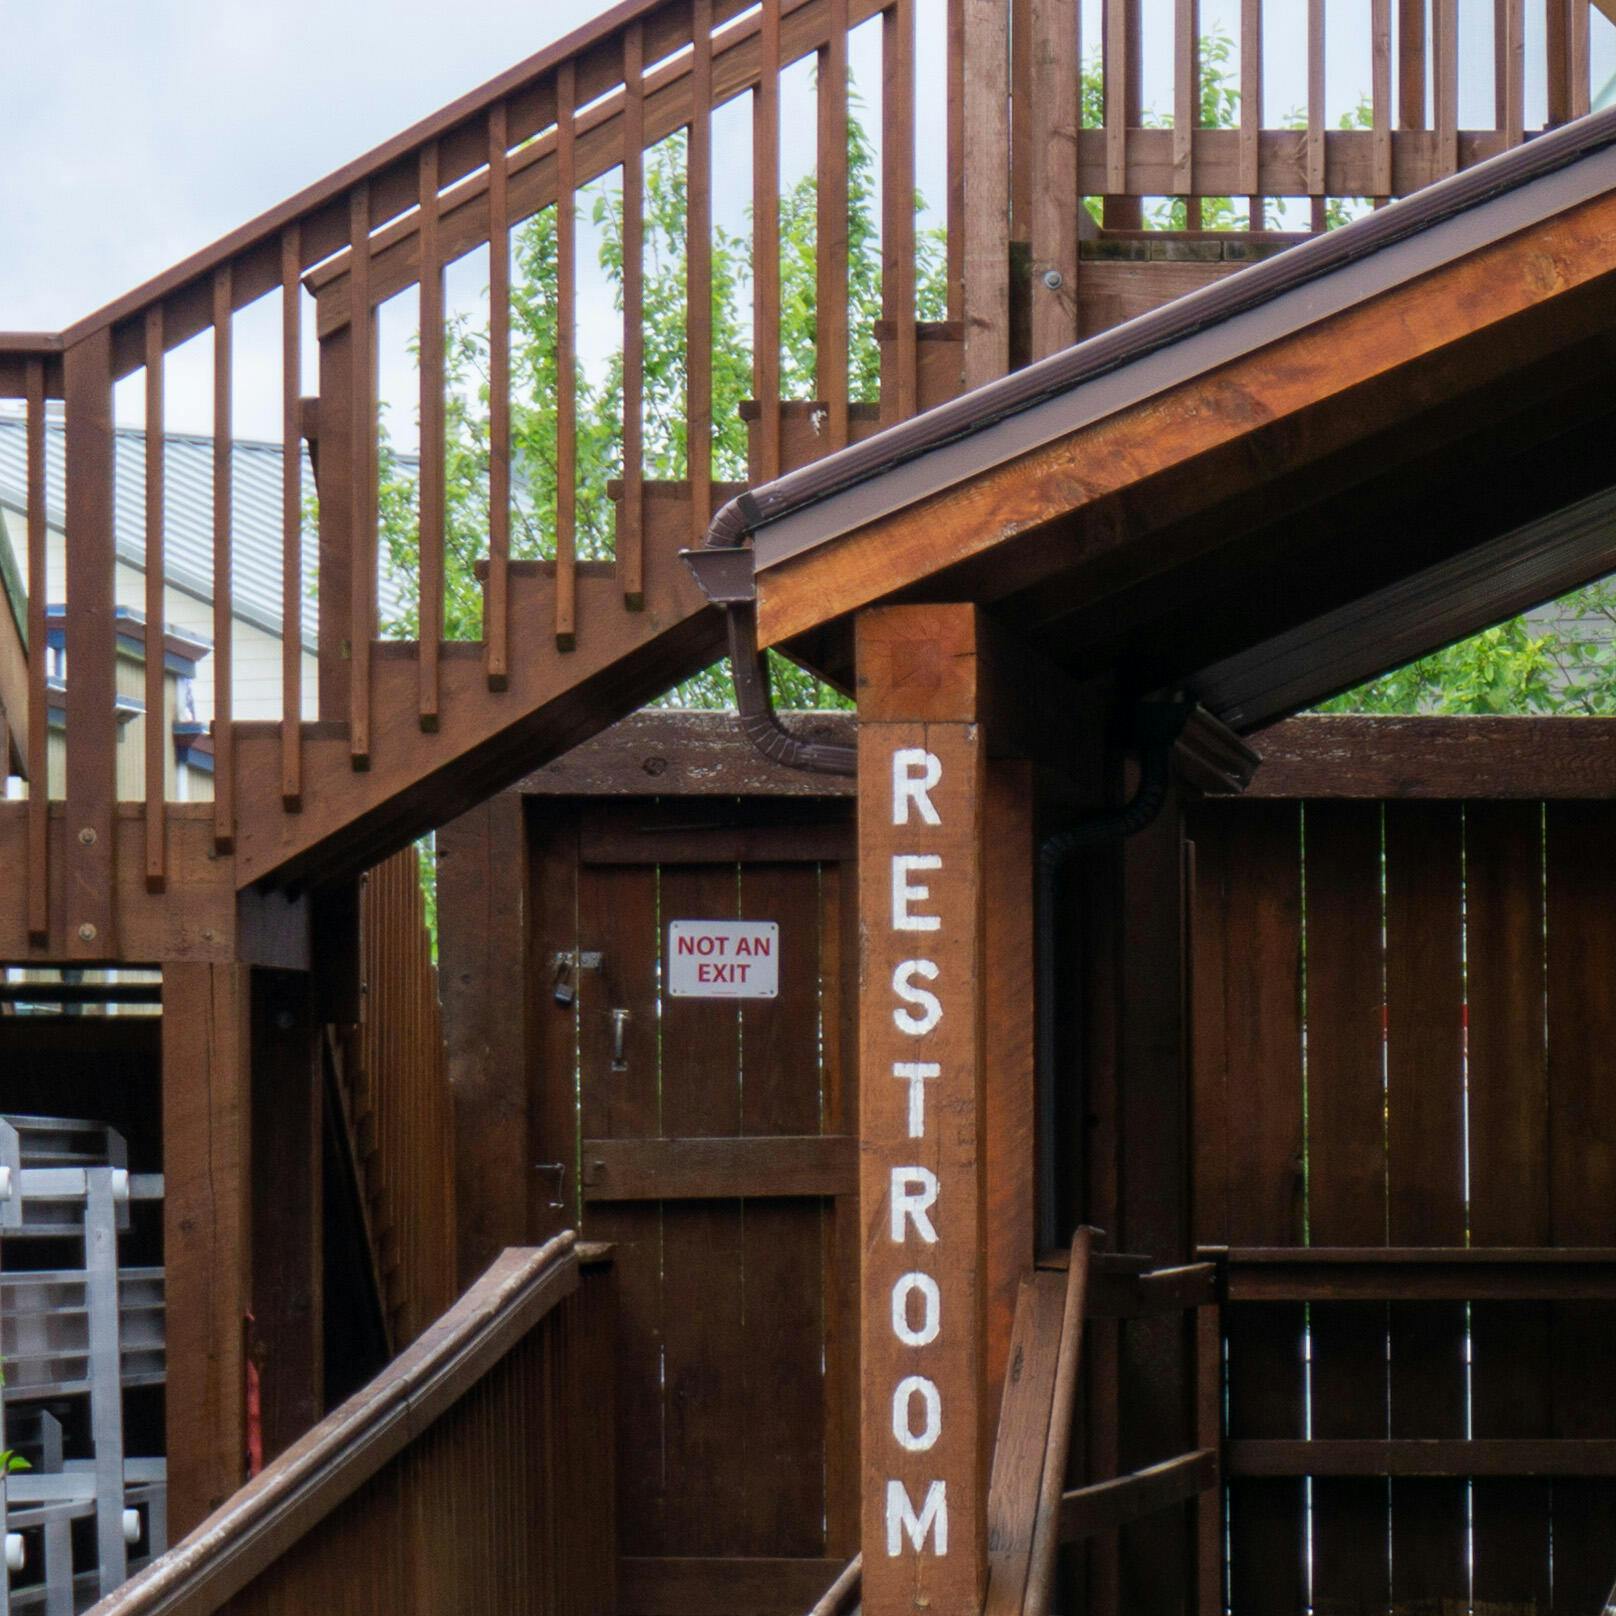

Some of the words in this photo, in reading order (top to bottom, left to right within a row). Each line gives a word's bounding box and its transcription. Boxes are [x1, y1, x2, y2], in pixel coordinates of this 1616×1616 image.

[678, 936, 729, 955] NOT
[736, 937, 770, 956] AN
[698, 964, 751, 983] EXIT
[885, 748, 948, 1557] RESTROOM
